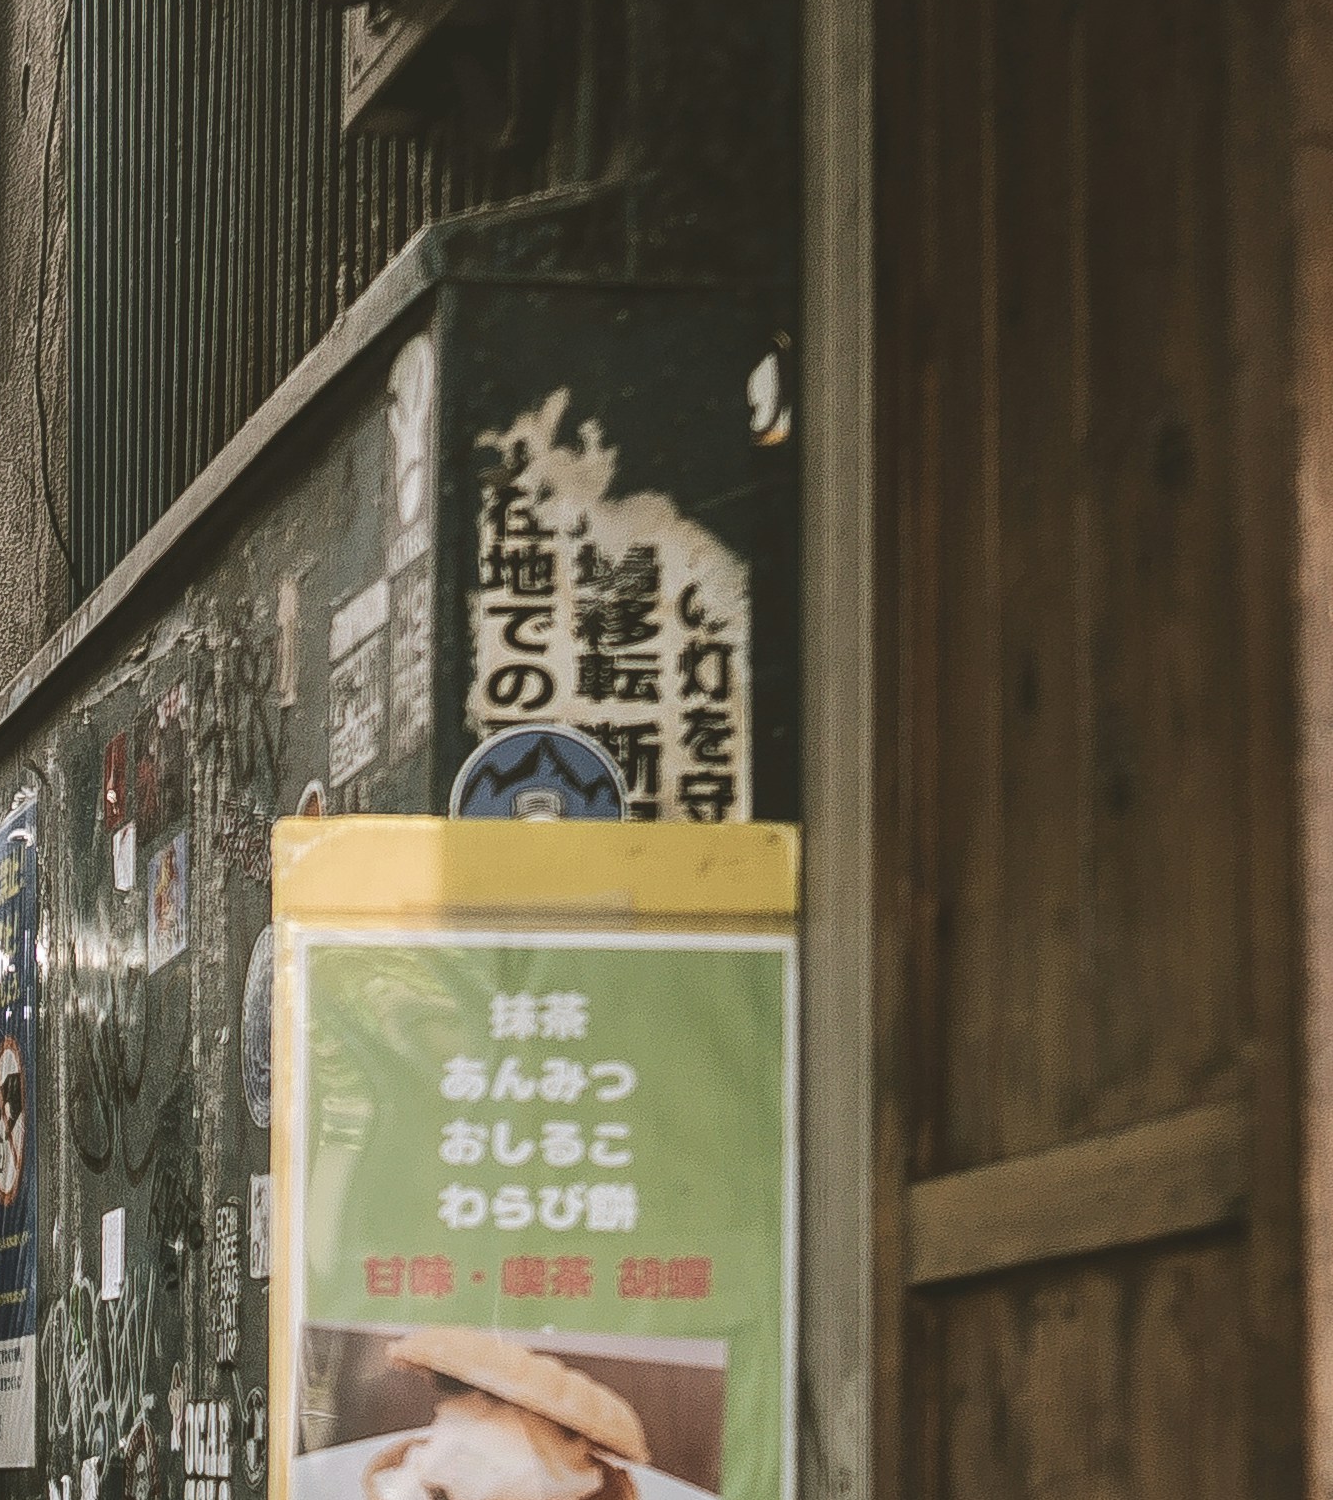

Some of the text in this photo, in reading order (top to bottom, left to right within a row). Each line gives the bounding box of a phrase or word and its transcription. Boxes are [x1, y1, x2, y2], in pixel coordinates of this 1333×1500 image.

[489, 991, 590, 1042] 抹茶
[440, 1055, 636, 1104] あんみつ
[439, 1118, 634, 1169] おしるこ
[439, 1181, 640, 1232] わらび餅
[364, 1254, 593, 1300] 甘味・喫茶
